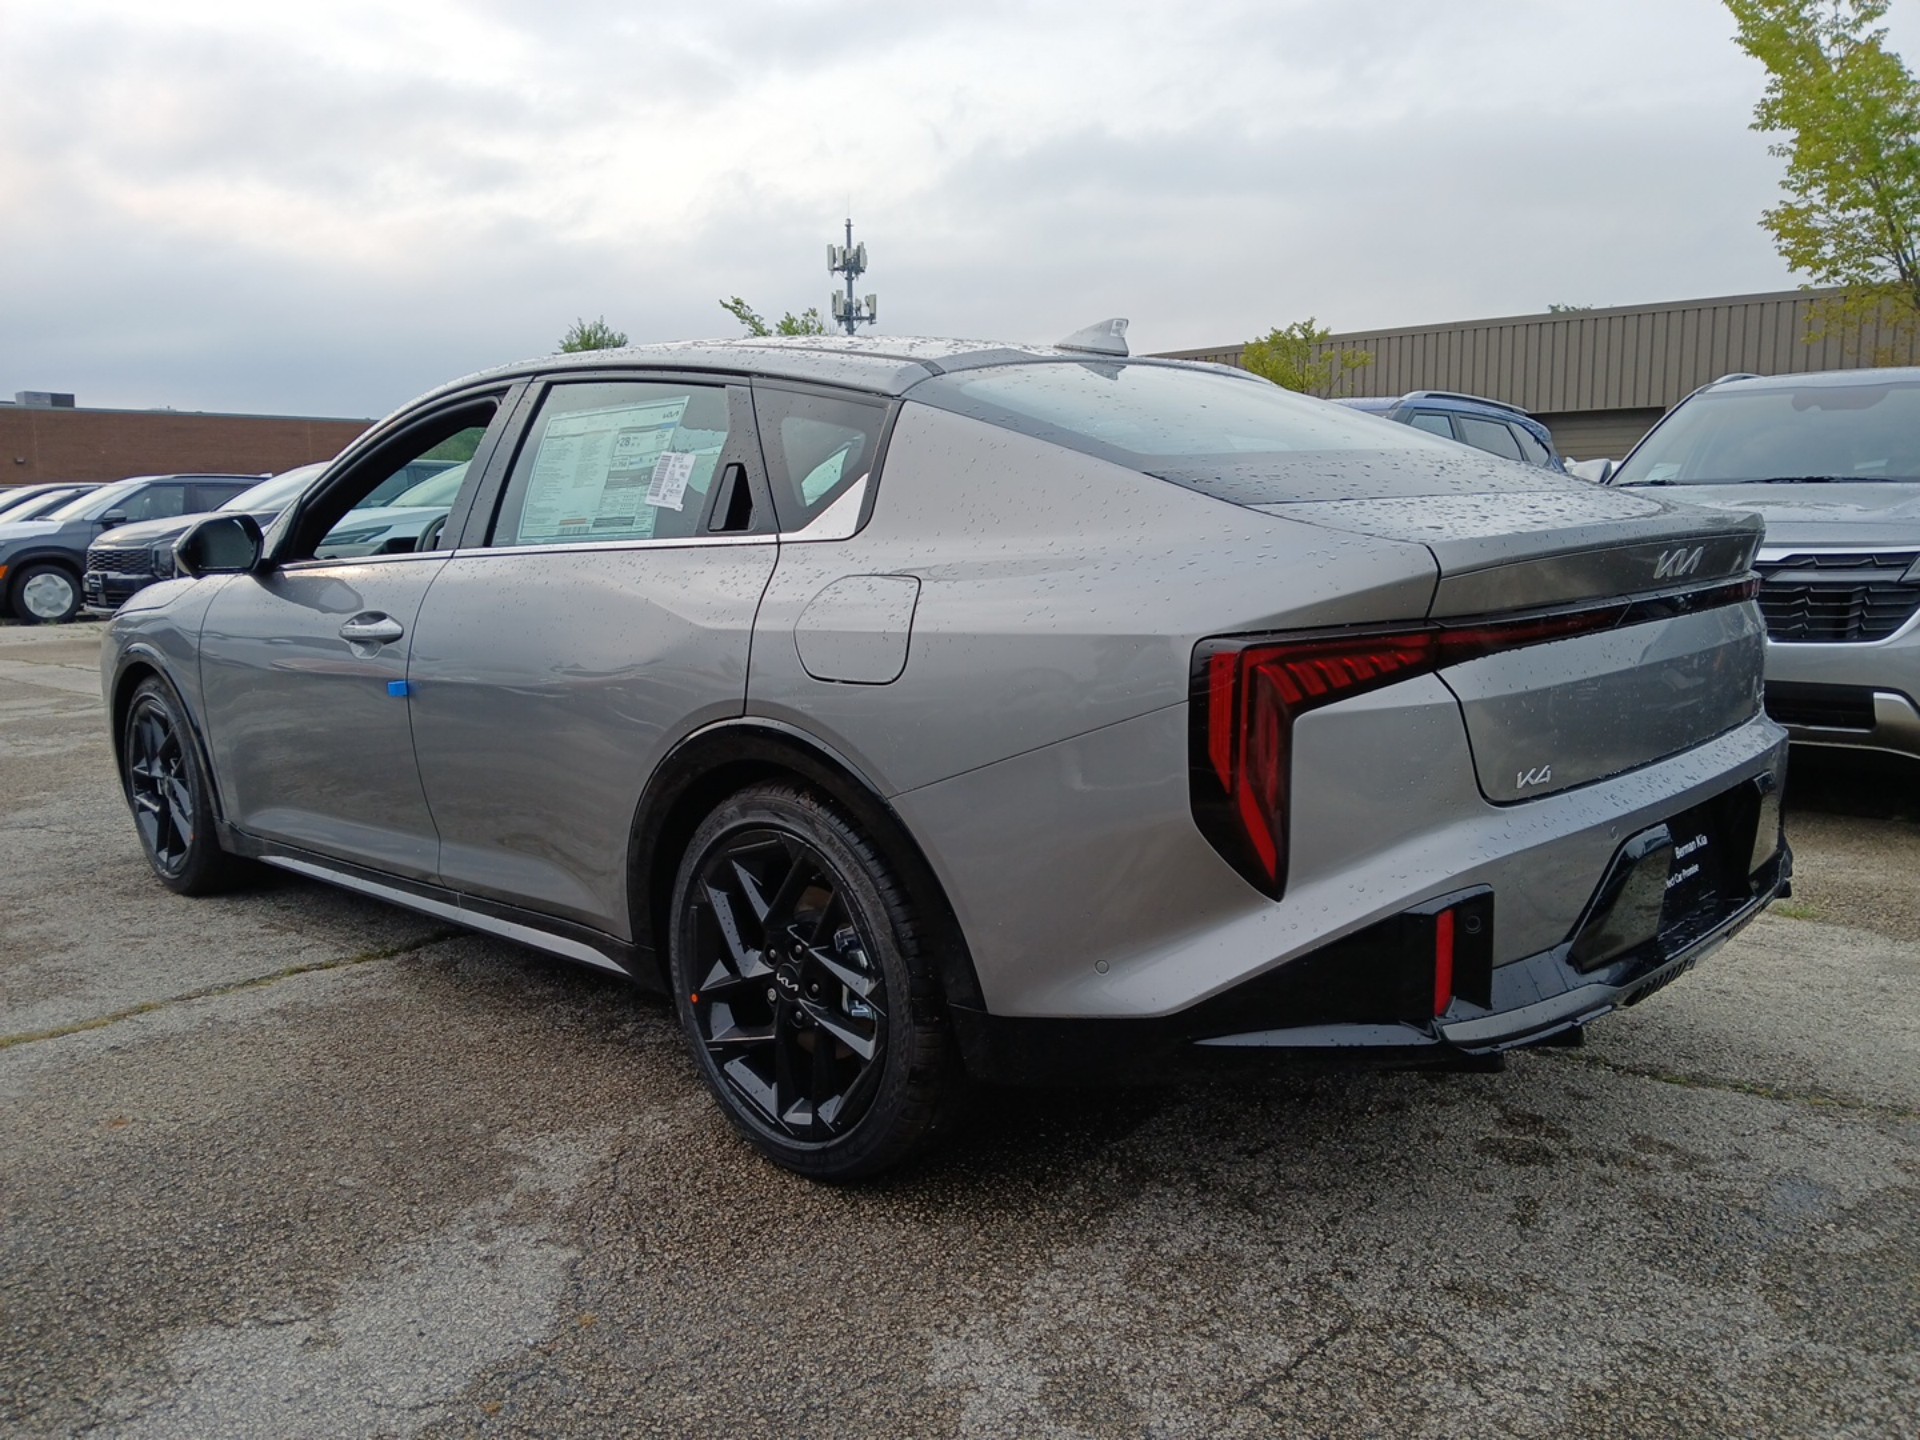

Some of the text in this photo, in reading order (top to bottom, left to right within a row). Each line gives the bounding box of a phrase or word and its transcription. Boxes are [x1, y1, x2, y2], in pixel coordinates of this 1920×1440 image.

[1653, 546, 1704, 579] KIA
[1516, 764, 1551, 788] K4
[776, 972, 799, 992] KIA
